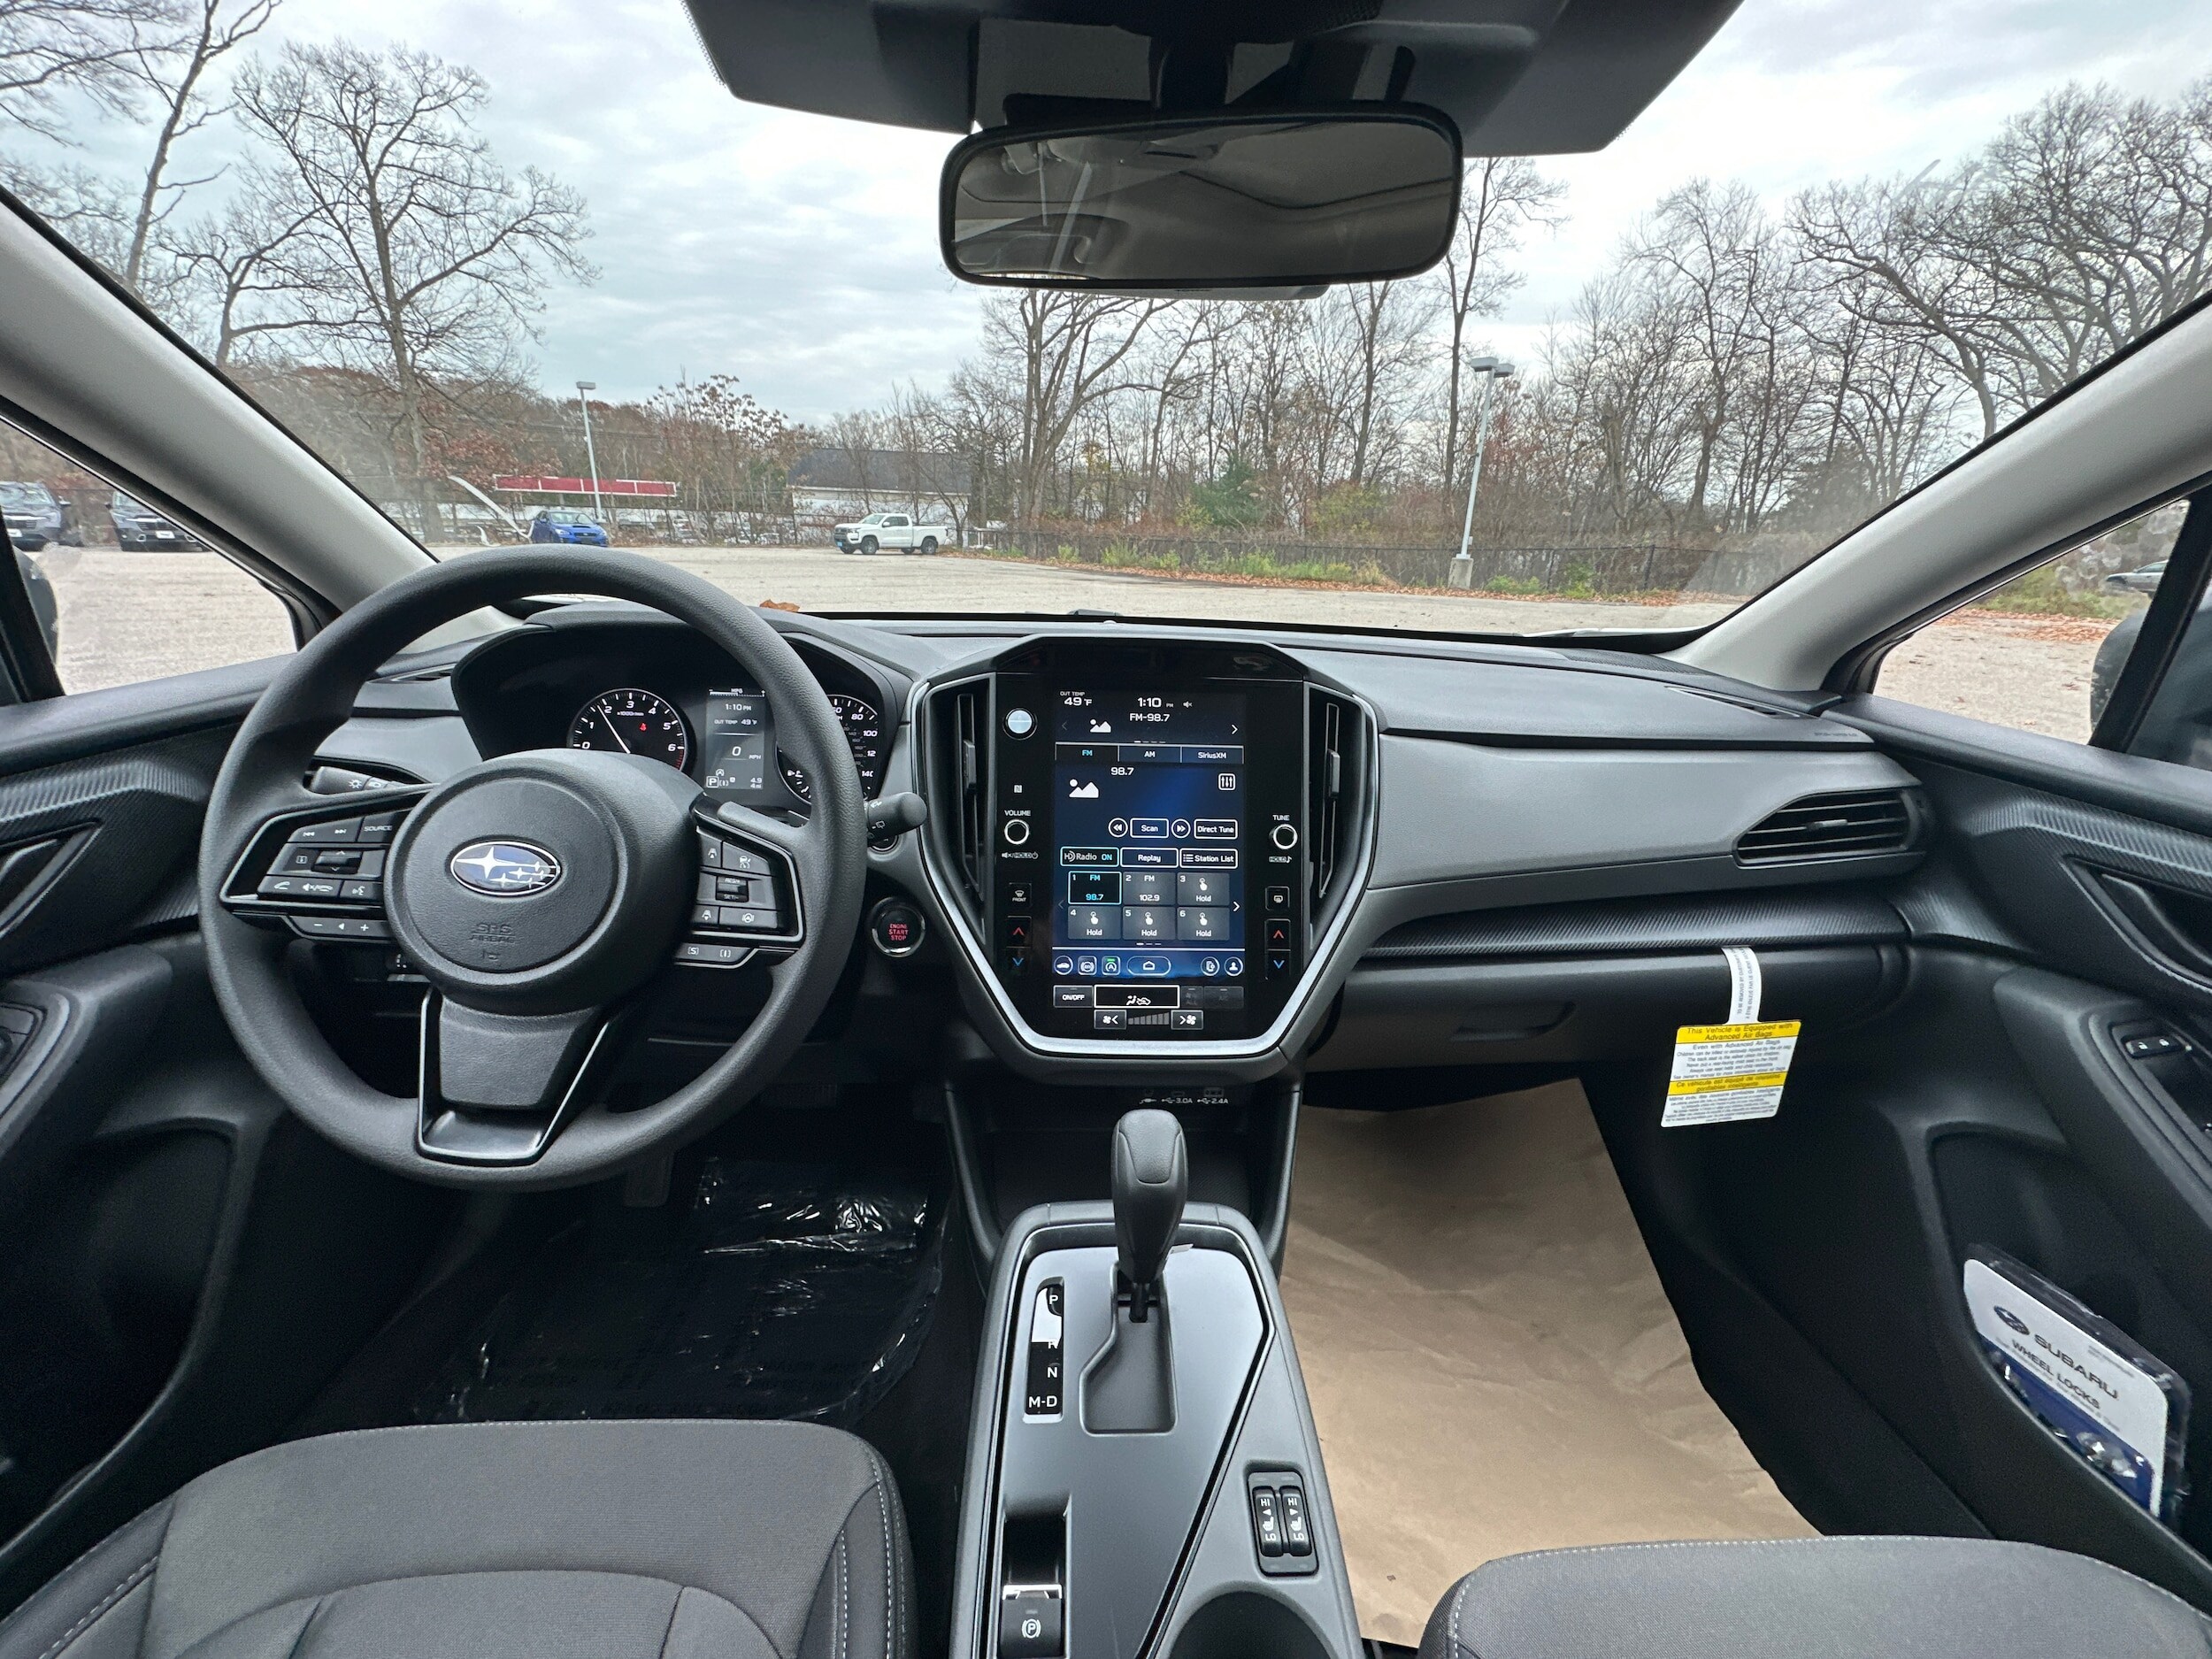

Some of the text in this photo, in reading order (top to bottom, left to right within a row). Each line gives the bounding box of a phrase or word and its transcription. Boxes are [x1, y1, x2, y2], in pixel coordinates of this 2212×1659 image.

[1064, 697, 1082, 706] 49
[1137, 697, 1162, 708] 1:10
[1129, 713, 1171, 722] FM-98.7
[732, 746, 741, 757] 0
[1110, 767, 1134, 776] 98.7
[1138, 854, 1161, 864] Replay
[1086, 893, 1104, 902] 98.7
[1755, 1031, 1772, 1040] Bags
[1049, 1295, 1058, 1305] P
[2012, 1340, 2055, 1377] WHEEL
[2034, 1334, 2118, 1399] SUBARU
[1047, 1367, 1058, 1379] N
[2057, 1373, 2101, 1409] LOCKS
[1028, 1395, 1057, 1408] M-D
[1265, 1532, 1277, 1541] LO
[1294, 1532, 1305, 1541] LO
